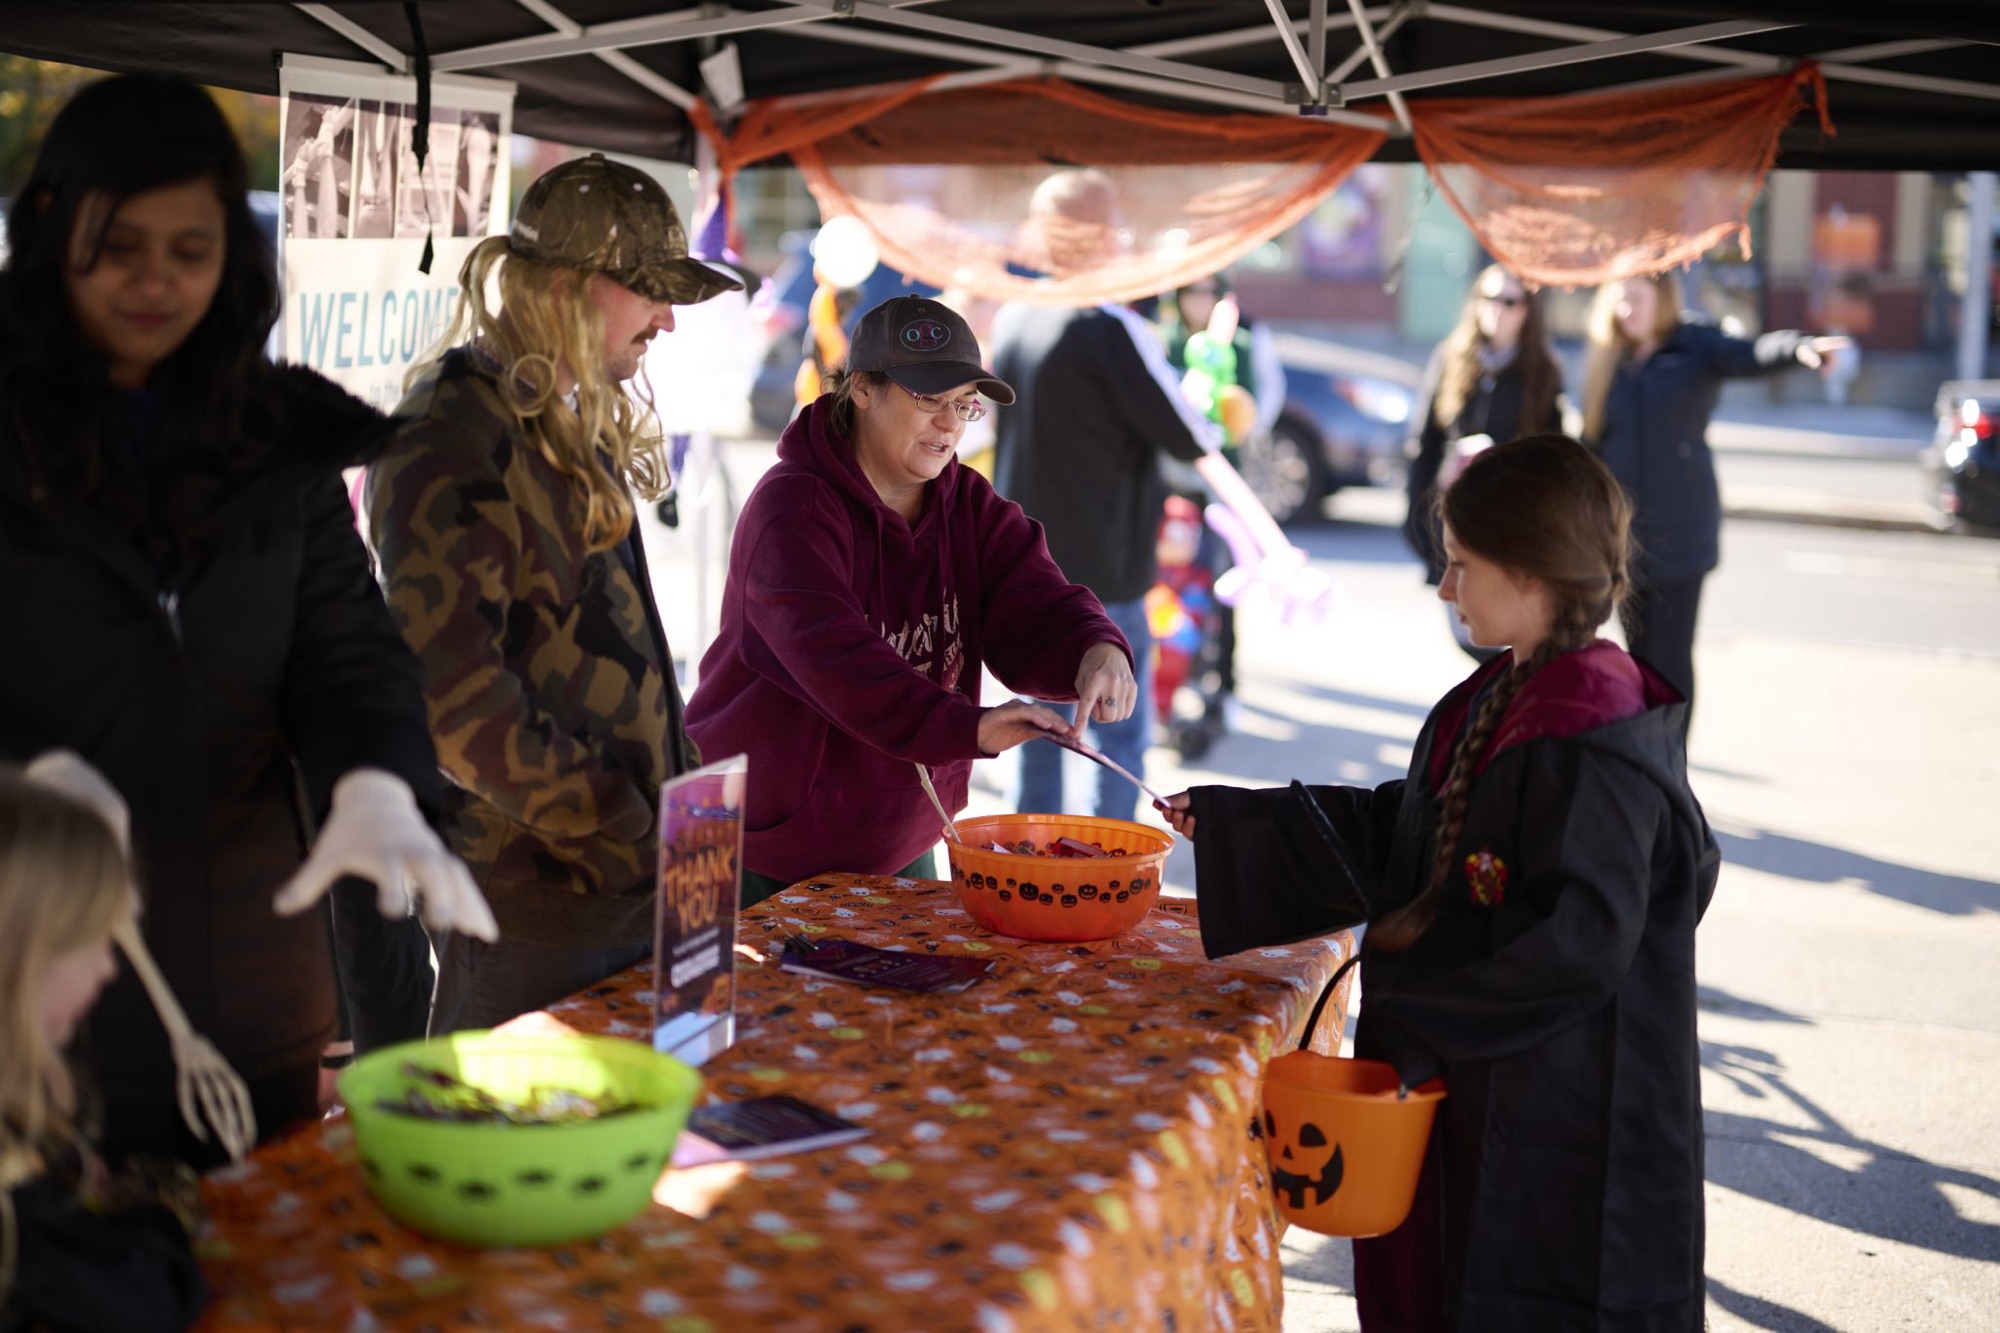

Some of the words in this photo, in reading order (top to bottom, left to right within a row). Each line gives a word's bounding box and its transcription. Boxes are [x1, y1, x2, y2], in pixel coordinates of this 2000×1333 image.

[299, 287, 459, 369] WELCOME
[665, 844, 736, 907] THANK
[676, 884, 721, 936] YOU
